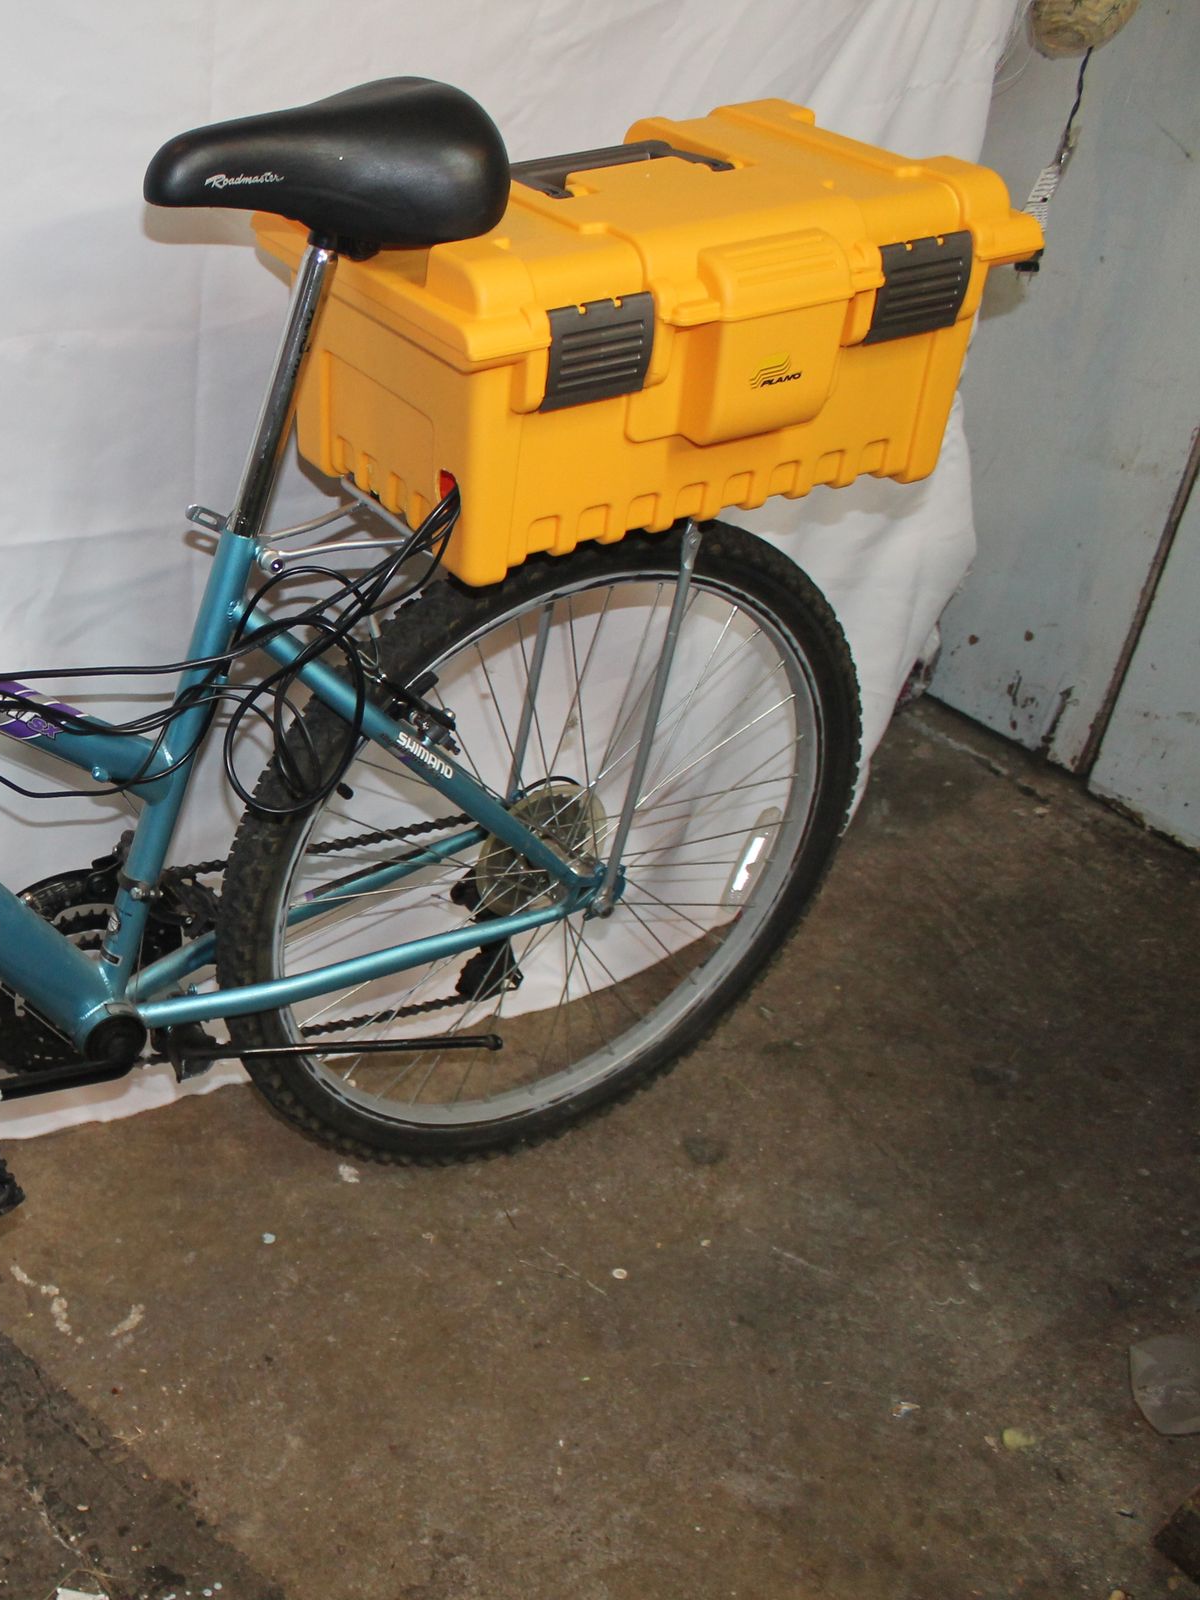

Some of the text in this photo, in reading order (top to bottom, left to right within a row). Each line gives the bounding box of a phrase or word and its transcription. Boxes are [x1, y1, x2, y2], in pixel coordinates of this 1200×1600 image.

[204, 171, 285, 189] Roadmaster
[760, 372, 802, 388] PLANO
[396, 731, 454, 779] SHIMANO
